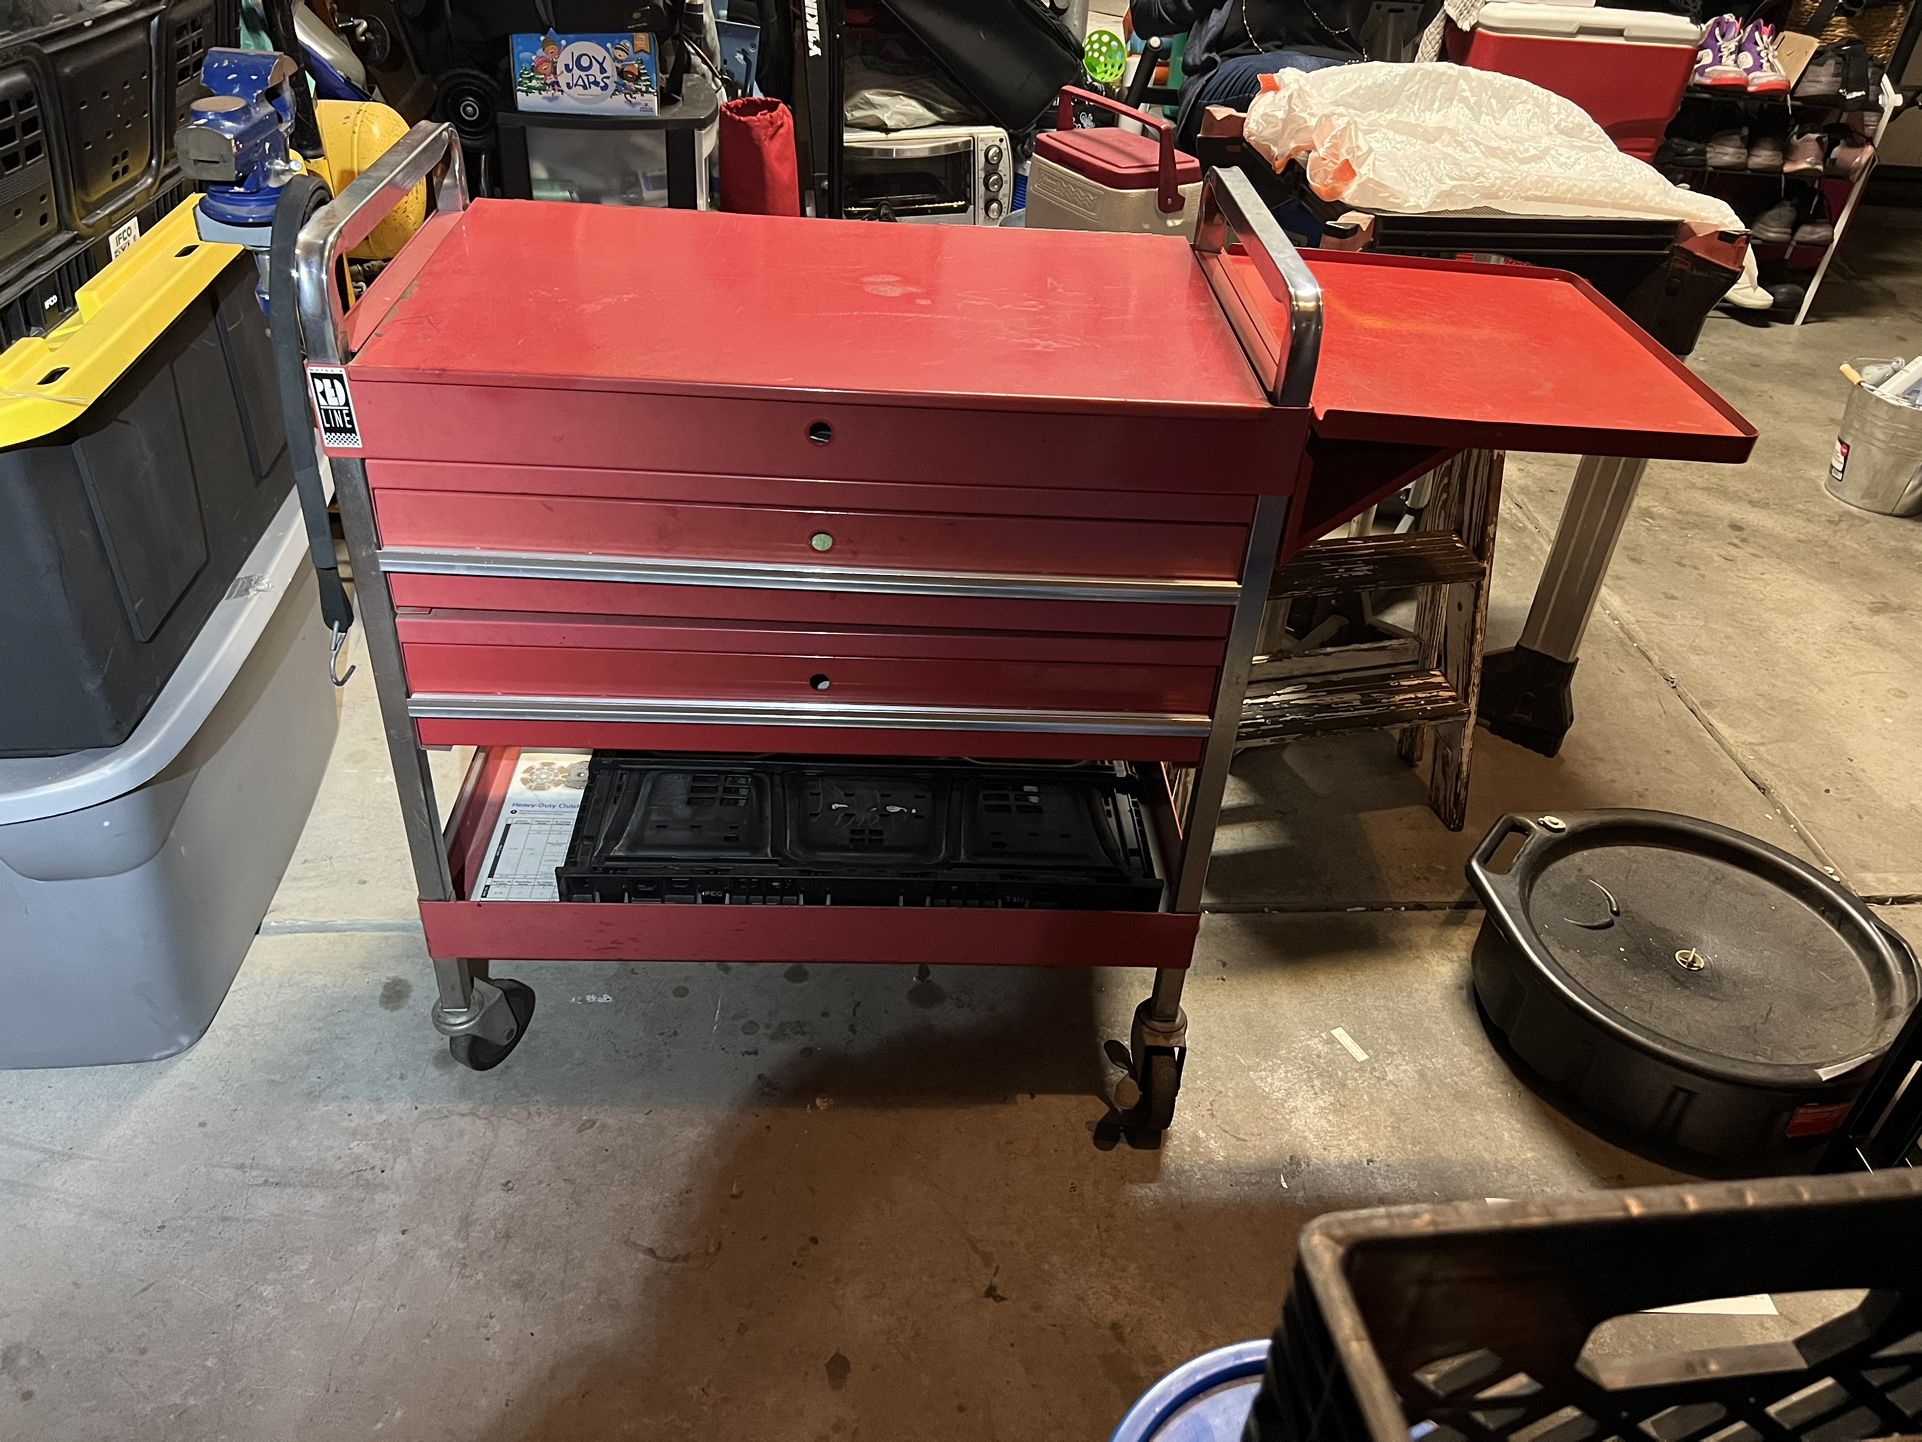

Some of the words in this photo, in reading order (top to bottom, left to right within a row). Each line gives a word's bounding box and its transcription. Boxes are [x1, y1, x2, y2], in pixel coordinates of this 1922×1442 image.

[564, 51, 608, 74] JOY
[566, 73, 611, 92] JARS
[115, 226, 133, 247] IFCO
[313, 377, 346, 407] RED
[320, 408, 353, 429] LINE
